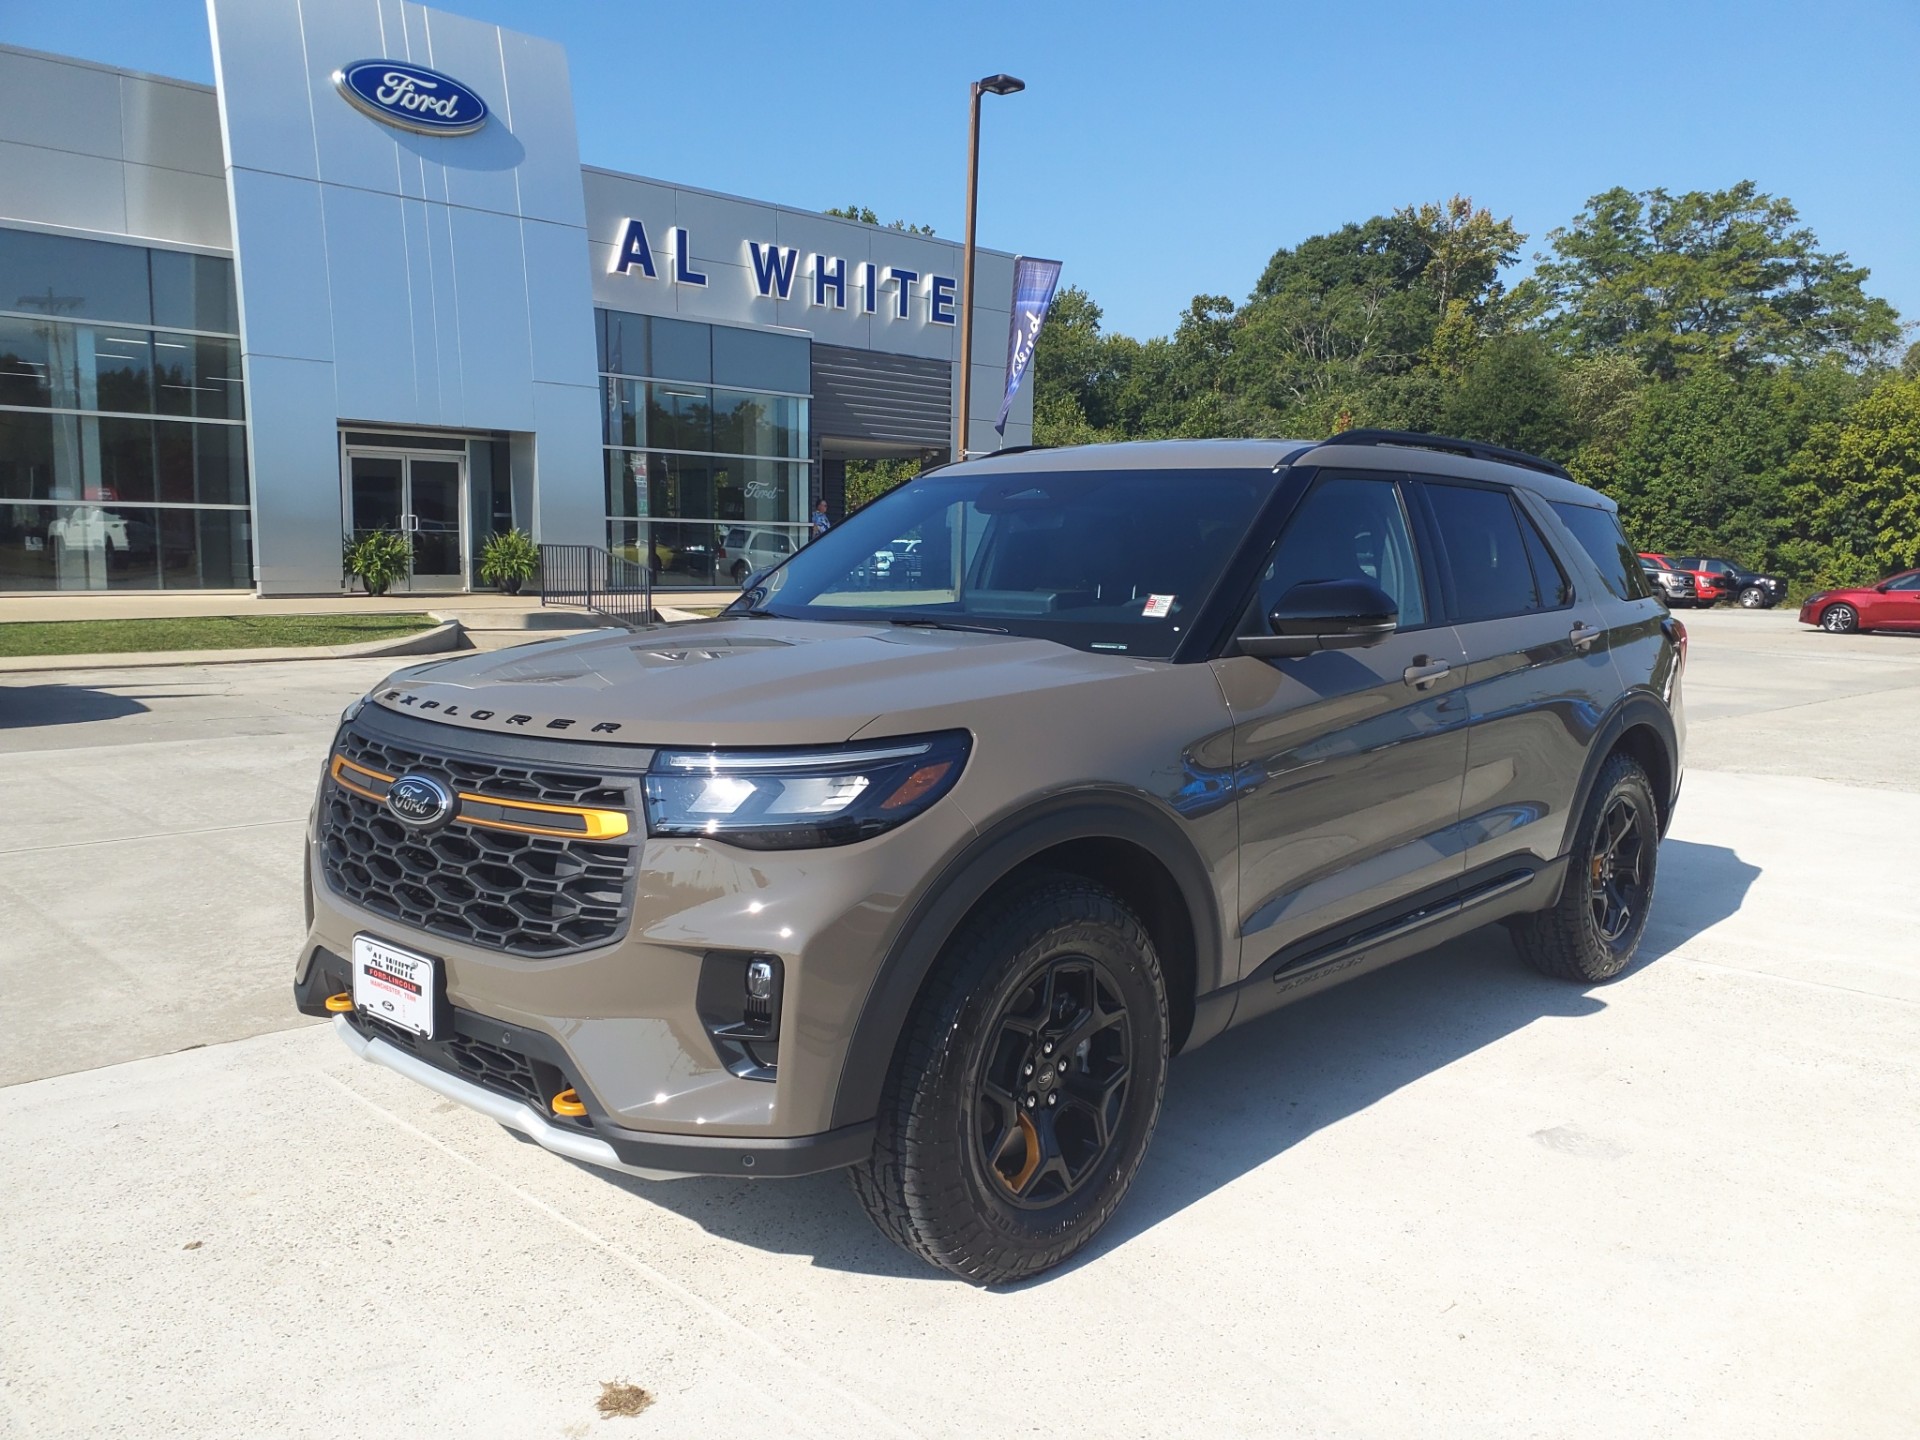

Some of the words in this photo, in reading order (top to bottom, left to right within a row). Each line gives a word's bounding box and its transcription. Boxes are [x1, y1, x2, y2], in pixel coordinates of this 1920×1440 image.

[376, 72, 458, 118] Ford
[609, 216, 709, 288] AL
[743, 238, 957, 327] WHITE
[744, 481, 777, 499] Ford
[384, 691, 622, 733] EXPLORER
[395, 785, 430, 814] Ford
[370, 952, 383, 968] AL
